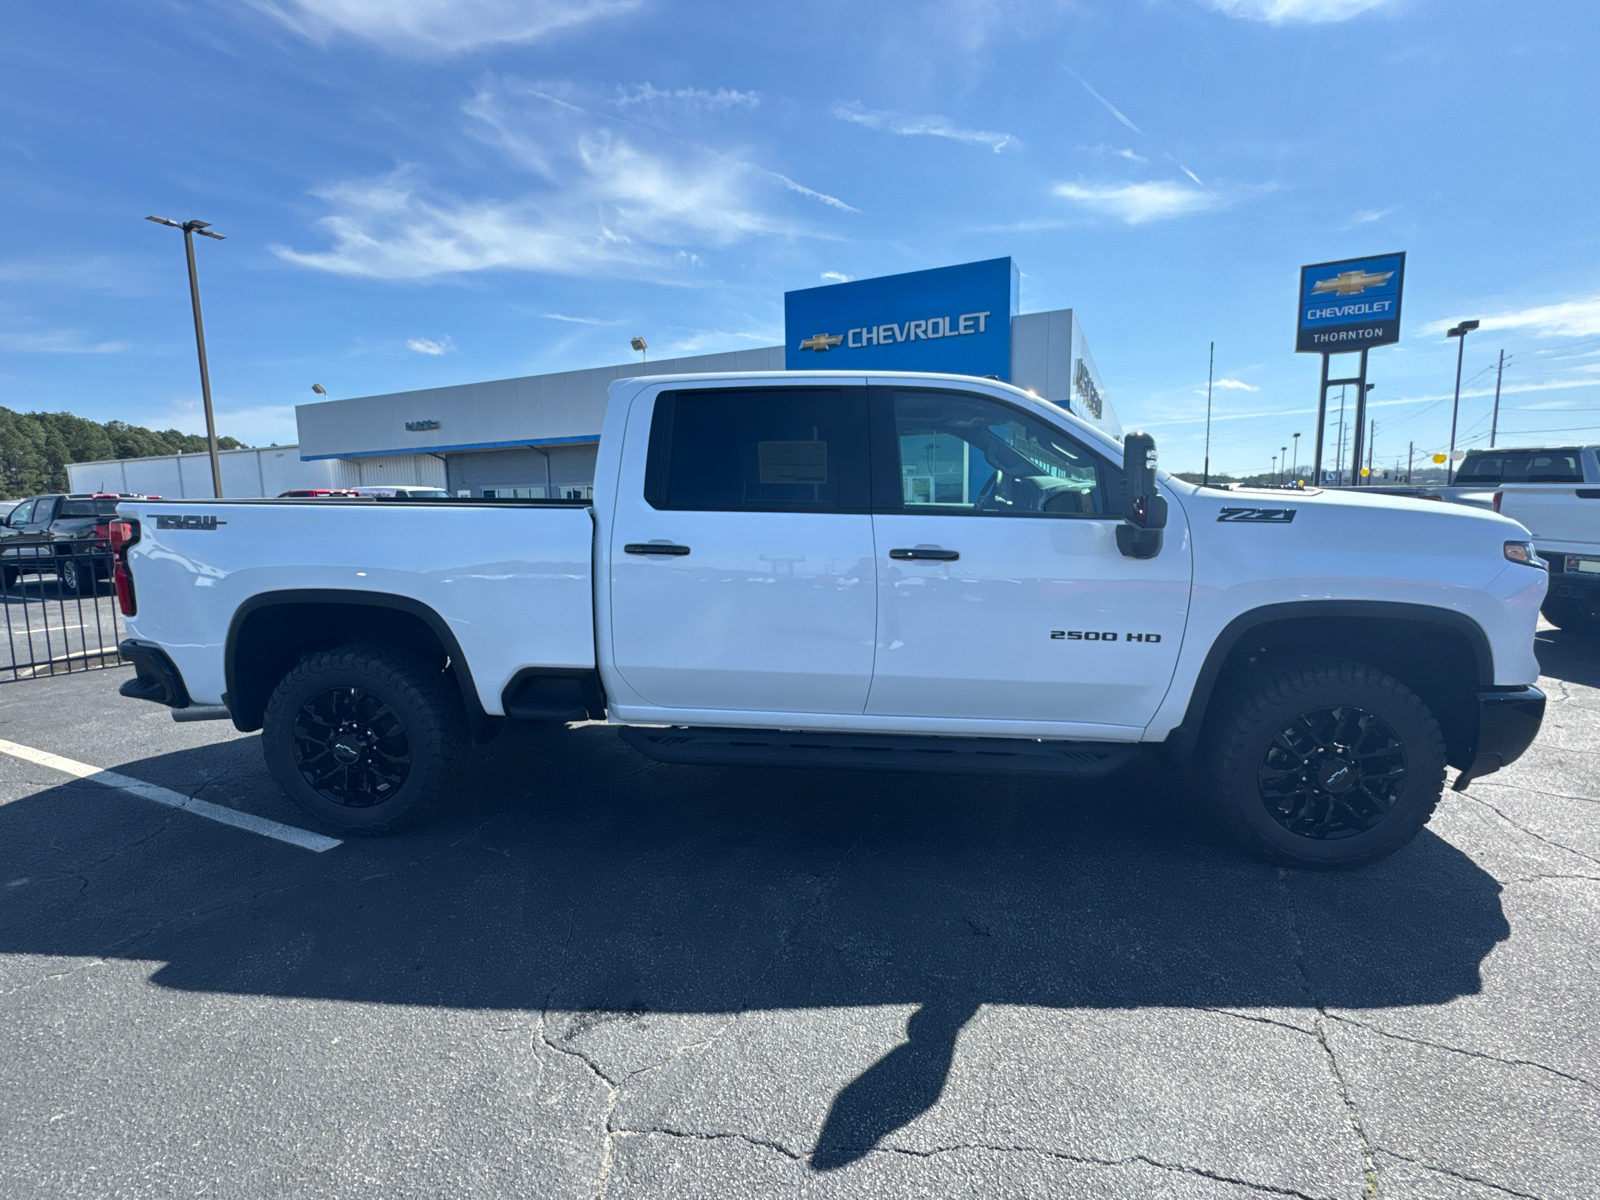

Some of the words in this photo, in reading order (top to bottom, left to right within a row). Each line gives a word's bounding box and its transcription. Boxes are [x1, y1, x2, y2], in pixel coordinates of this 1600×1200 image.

[1307, 300, 1392, 320] CHEVROLET
[847, 311, 991, 349] CHEVROLET
[1313, 327, 1384, 343] THORNTON
[1050, 630, 1118, 642] 2500
[1126, 632, 1162, 643] HD
